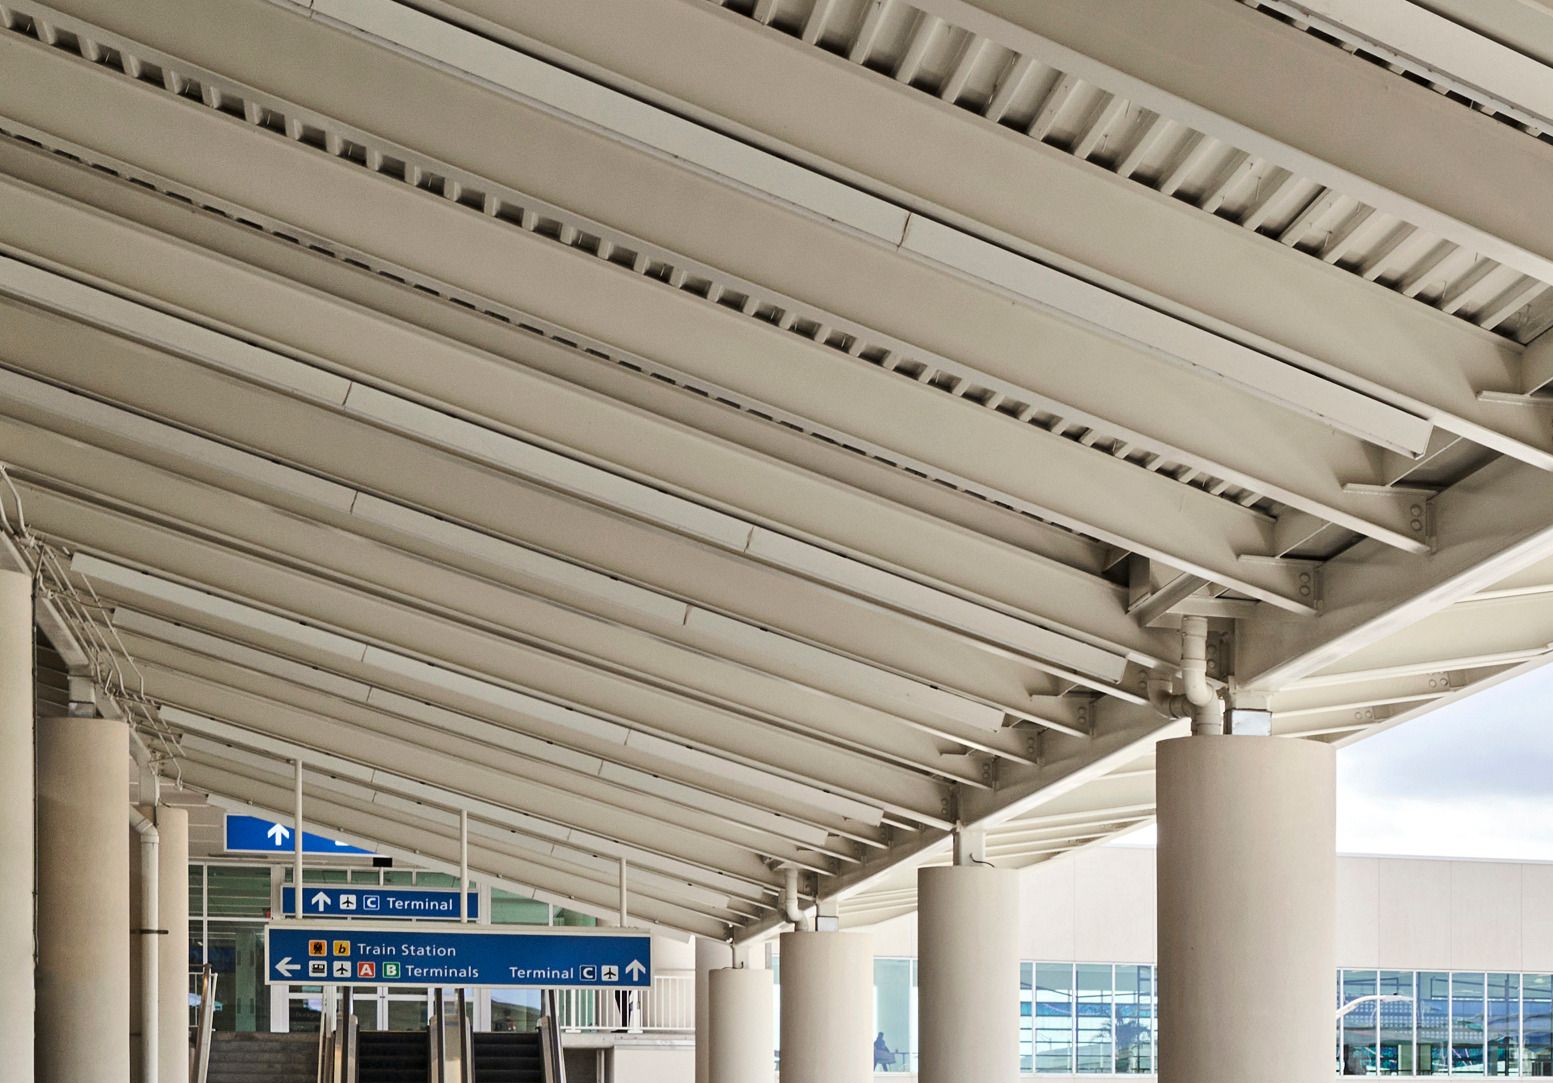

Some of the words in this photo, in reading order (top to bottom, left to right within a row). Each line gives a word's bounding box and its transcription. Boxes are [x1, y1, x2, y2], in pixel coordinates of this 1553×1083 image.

[386, 897, 453, 910] Terminal
[357, 943, 396, 955] Train
[401, 944, 456, 957] Station
[405, 965, 479, 978] Terminals
[509, 966, 574, 979] Terminal
